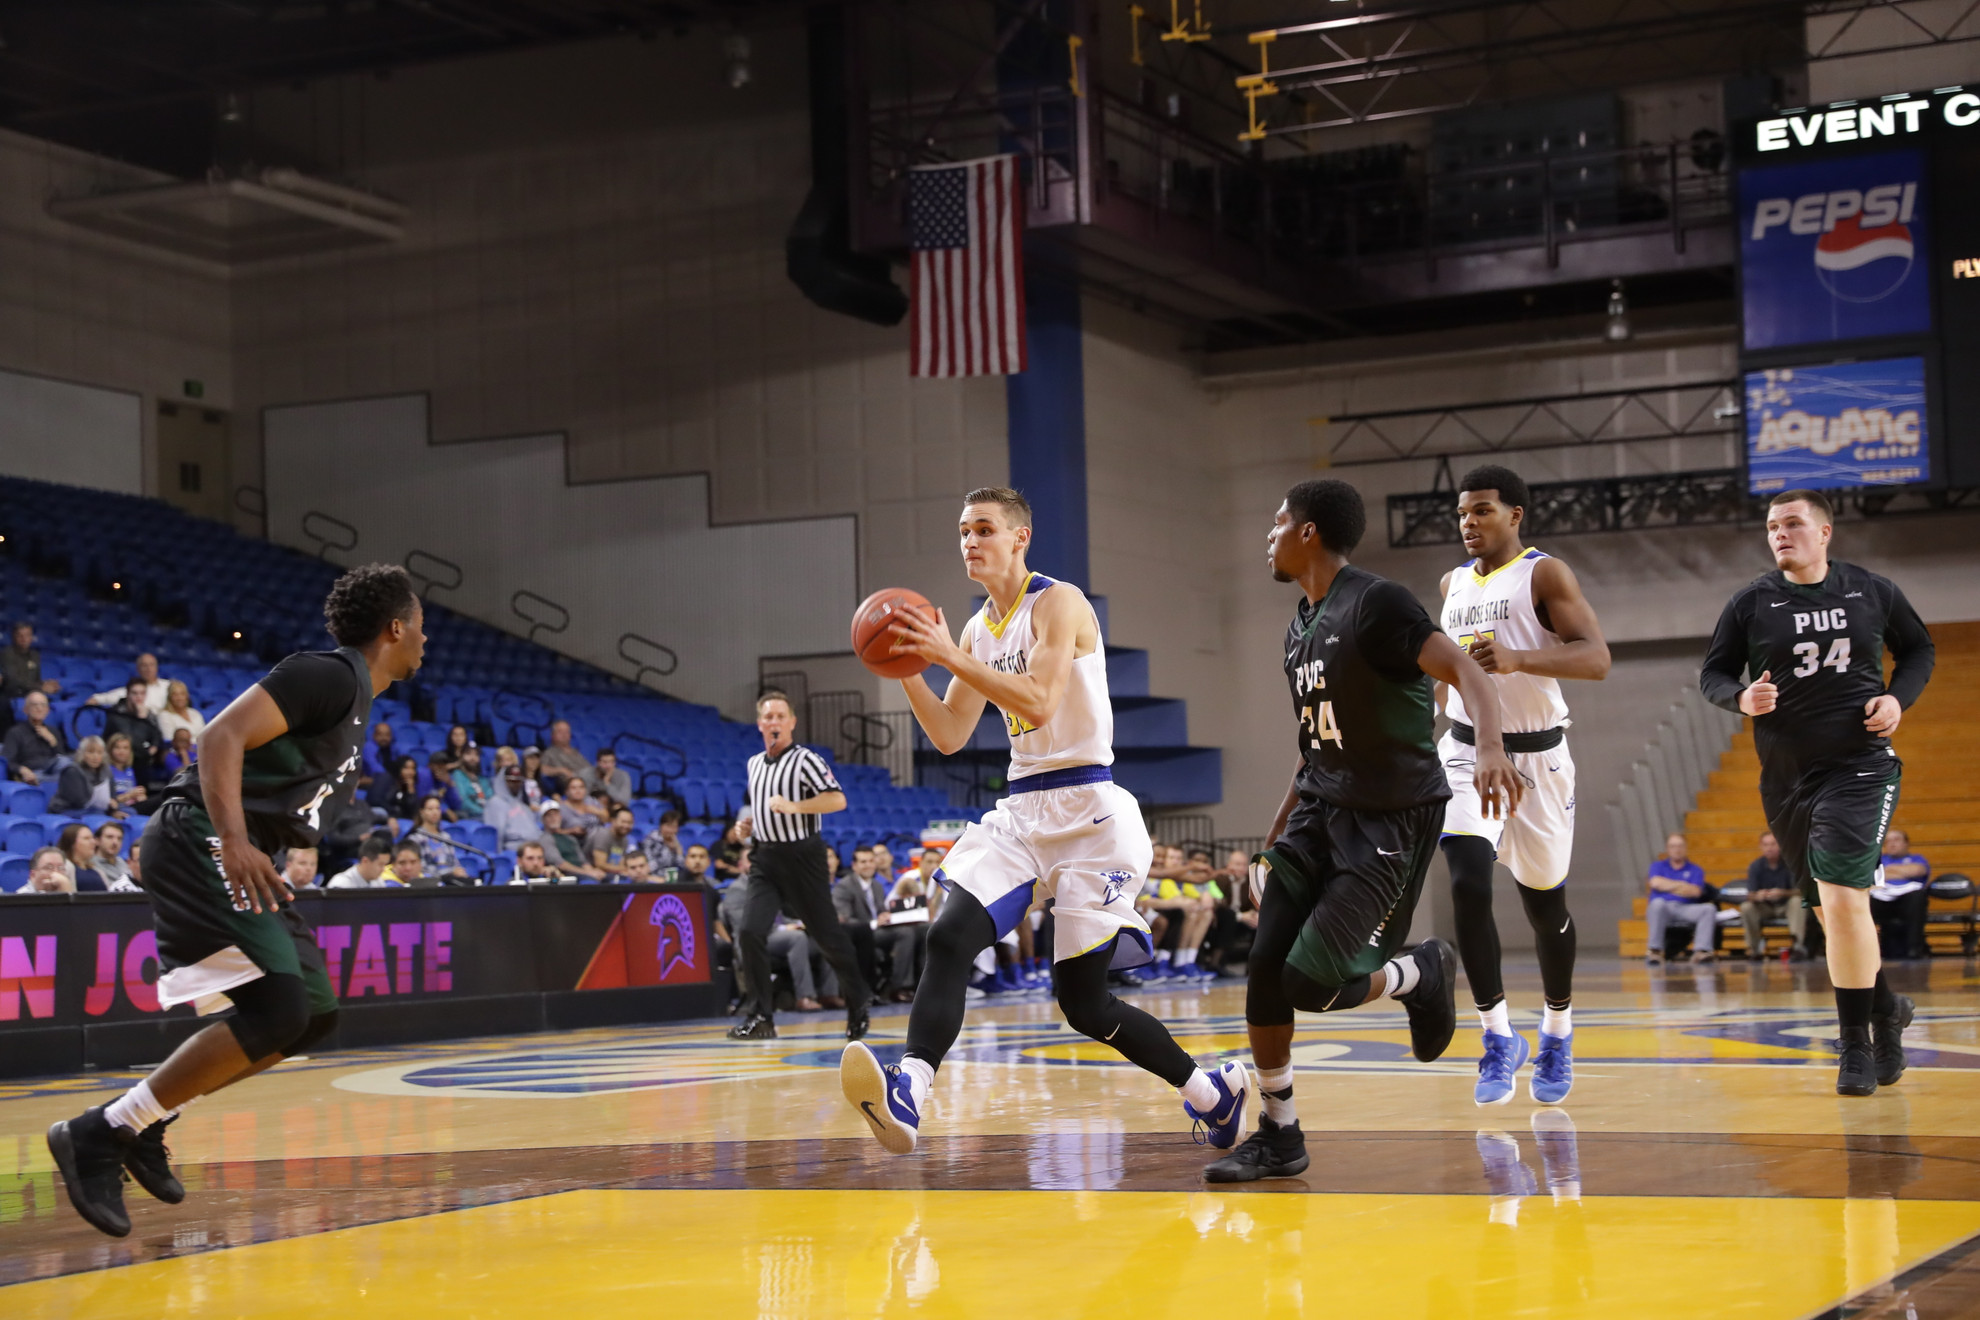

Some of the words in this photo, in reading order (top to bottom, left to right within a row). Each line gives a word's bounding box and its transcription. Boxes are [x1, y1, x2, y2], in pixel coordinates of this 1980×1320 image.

[1756, 100, 1929, 152] EVENT
[1751, 182, 1918, 240] PEPSI
[1449, 608, 1464, 629] SAN
[1793, 608, 1848, 634] PUC
[1295, 659, 1326, 697] PUC
[1792, 637, 1852, 678] 34
[310, 921, 453, 998] TATE
